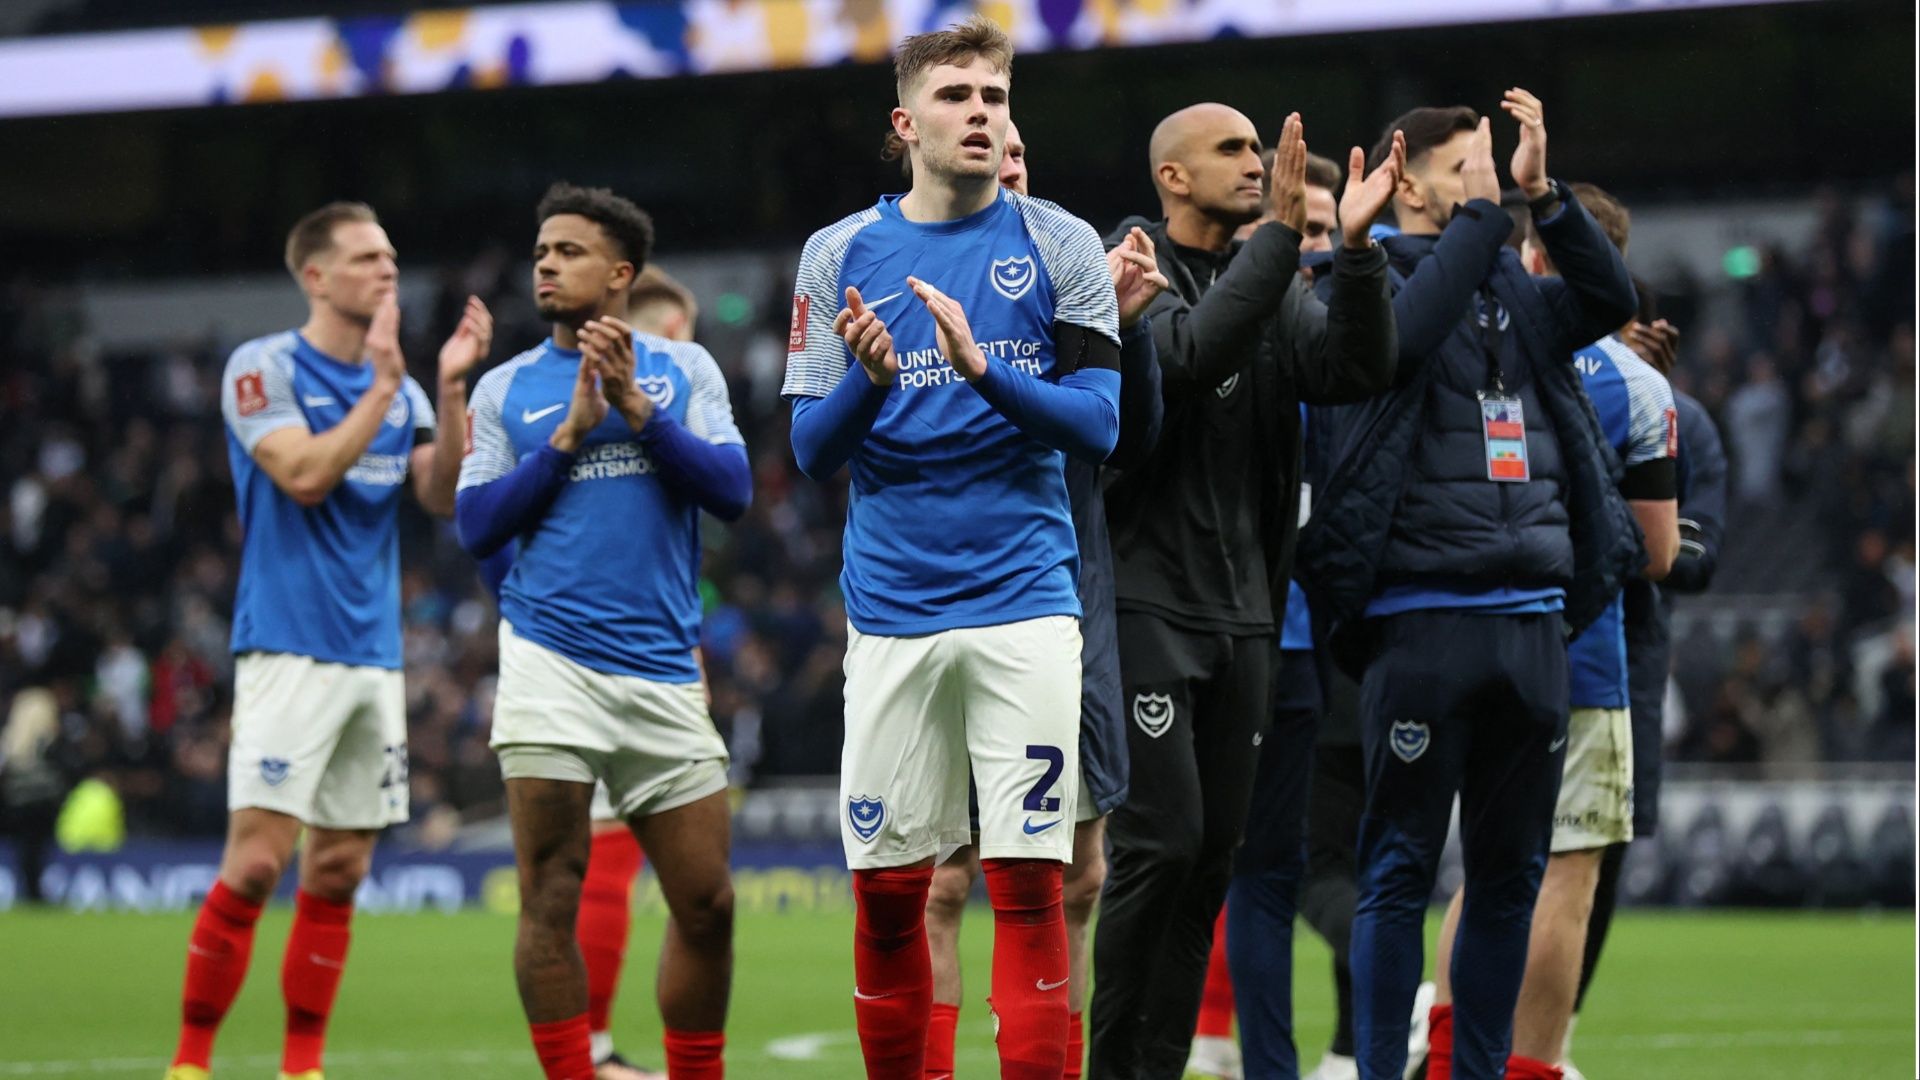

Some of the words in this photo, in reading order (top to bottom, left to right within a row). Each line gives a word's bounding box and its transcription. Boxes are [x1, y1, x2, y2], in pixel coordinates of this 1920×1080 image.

[897, 339, 1022, 370] UNIVITY
[1022, 342, 1041, 356] OF
[900, 358, 1042, 390] PORTSTH
[1023, 745, 1064, 812] 2
